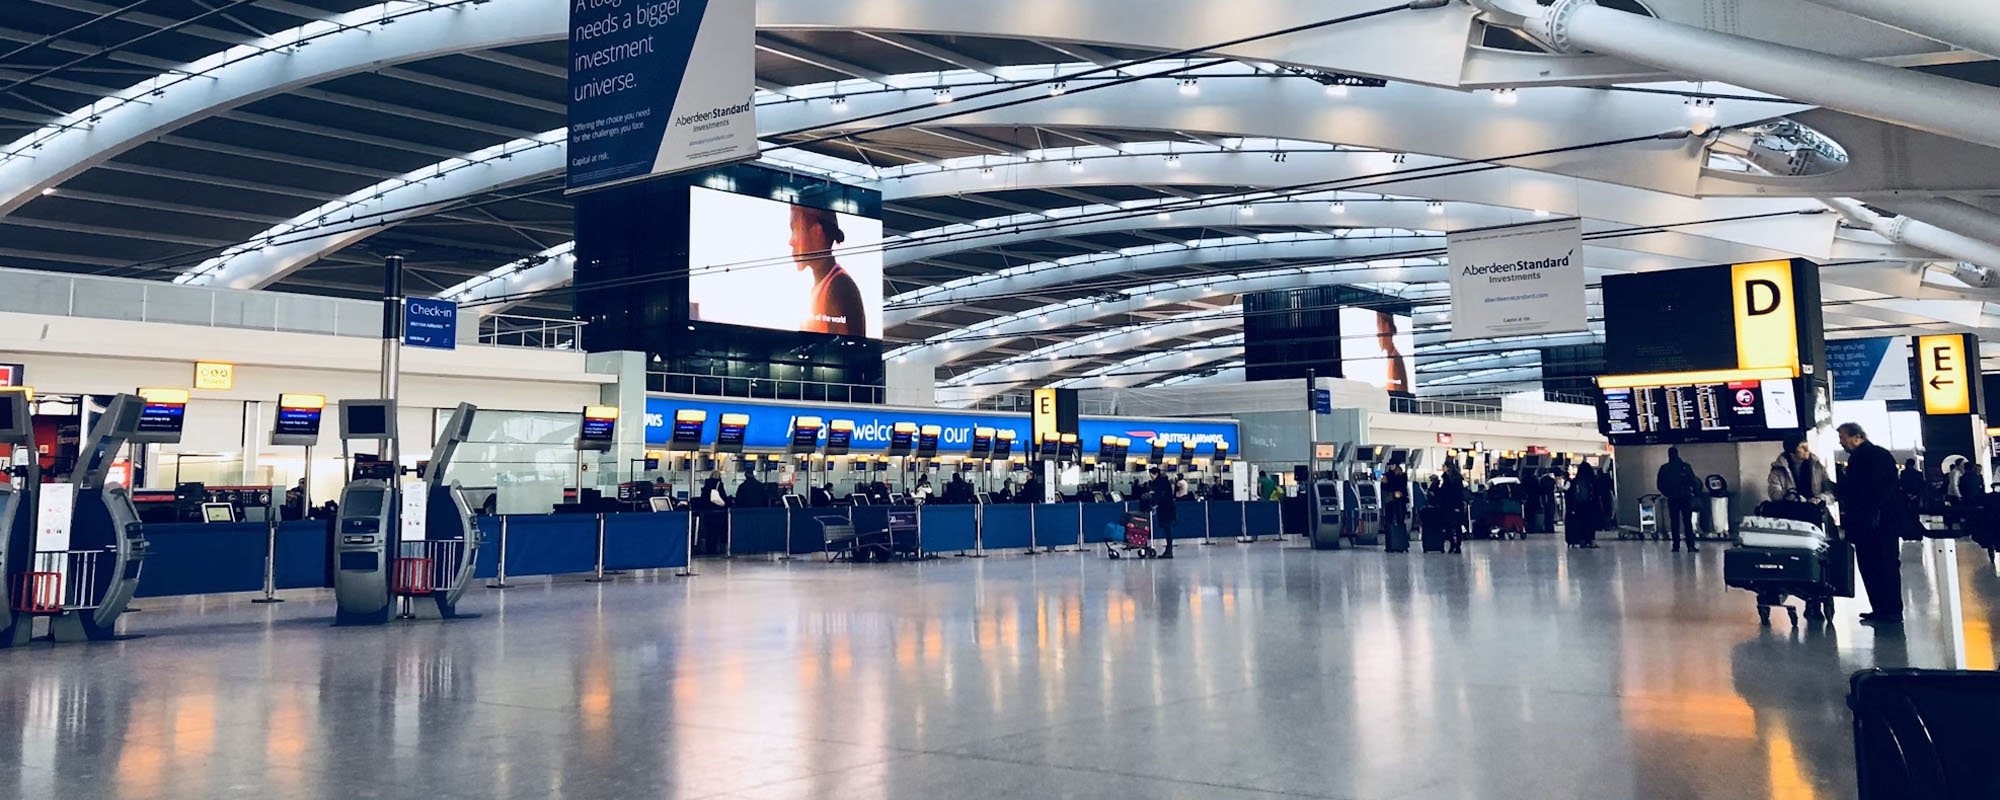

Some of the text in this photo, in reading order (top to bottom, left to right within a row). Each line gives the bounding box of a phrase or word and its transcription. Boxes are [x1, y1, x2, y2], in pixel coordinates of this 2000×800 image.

[576, 0, 680, 42] needs a bigger
[575, 34, 654, 72] investment
[575, 72, 637, 101] universe.
[573, 107, 650, 132] Offering the choice you need
[592, 127, 619, 139] challenges
[620, 124, 631, 134] you
[693, 119, 730, 132] Investments
[572, 155, 591, 167] Capital
[1489, 272, 1541, 284] Investments
[1745, 279, 1781, 316] D
[410, 303, 452, 318] Check-in
[1933, 346, 1952, 371] E
[1041, 397, 1050, 414] E
[851, 418, 920, 442] welcoe
[944, 427, 970, 443] our
